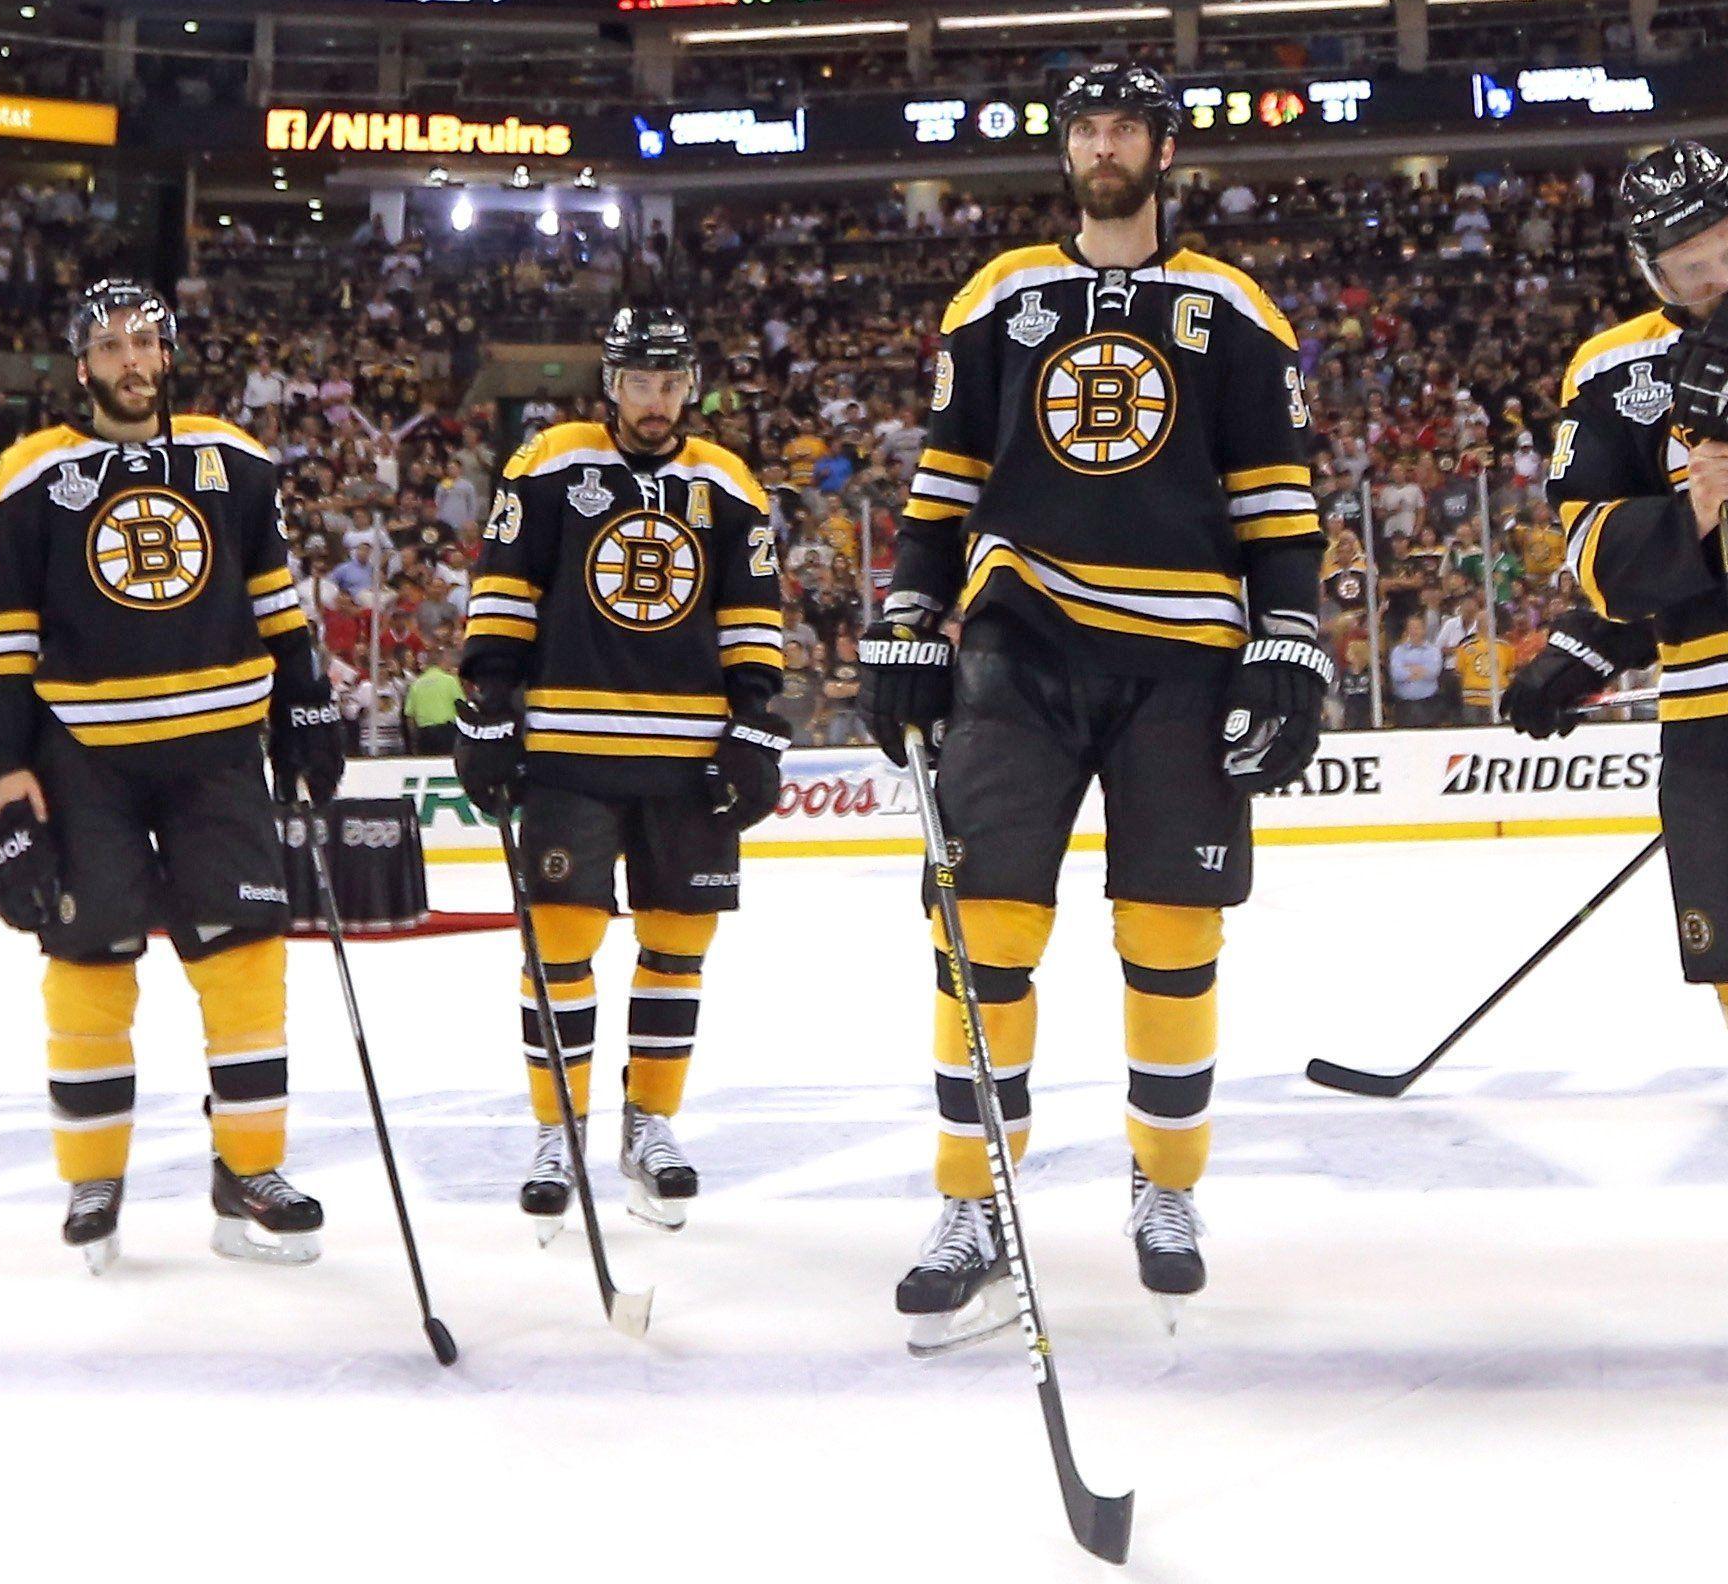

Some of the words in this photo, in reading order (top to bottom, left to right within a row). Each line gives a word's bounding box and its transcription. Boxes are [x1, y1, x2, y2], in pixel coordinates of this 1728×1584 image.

[1173, 293, 1214, 354] C
[1286, 365, 1310, 429] 3
[193, 445, 230, 492] A
[483, 489, 523, 545] 23
[685, 481, 713, 529] A
[748, 525, 781, 577] 2
[1548, 630, 1614, 677] BAUER
